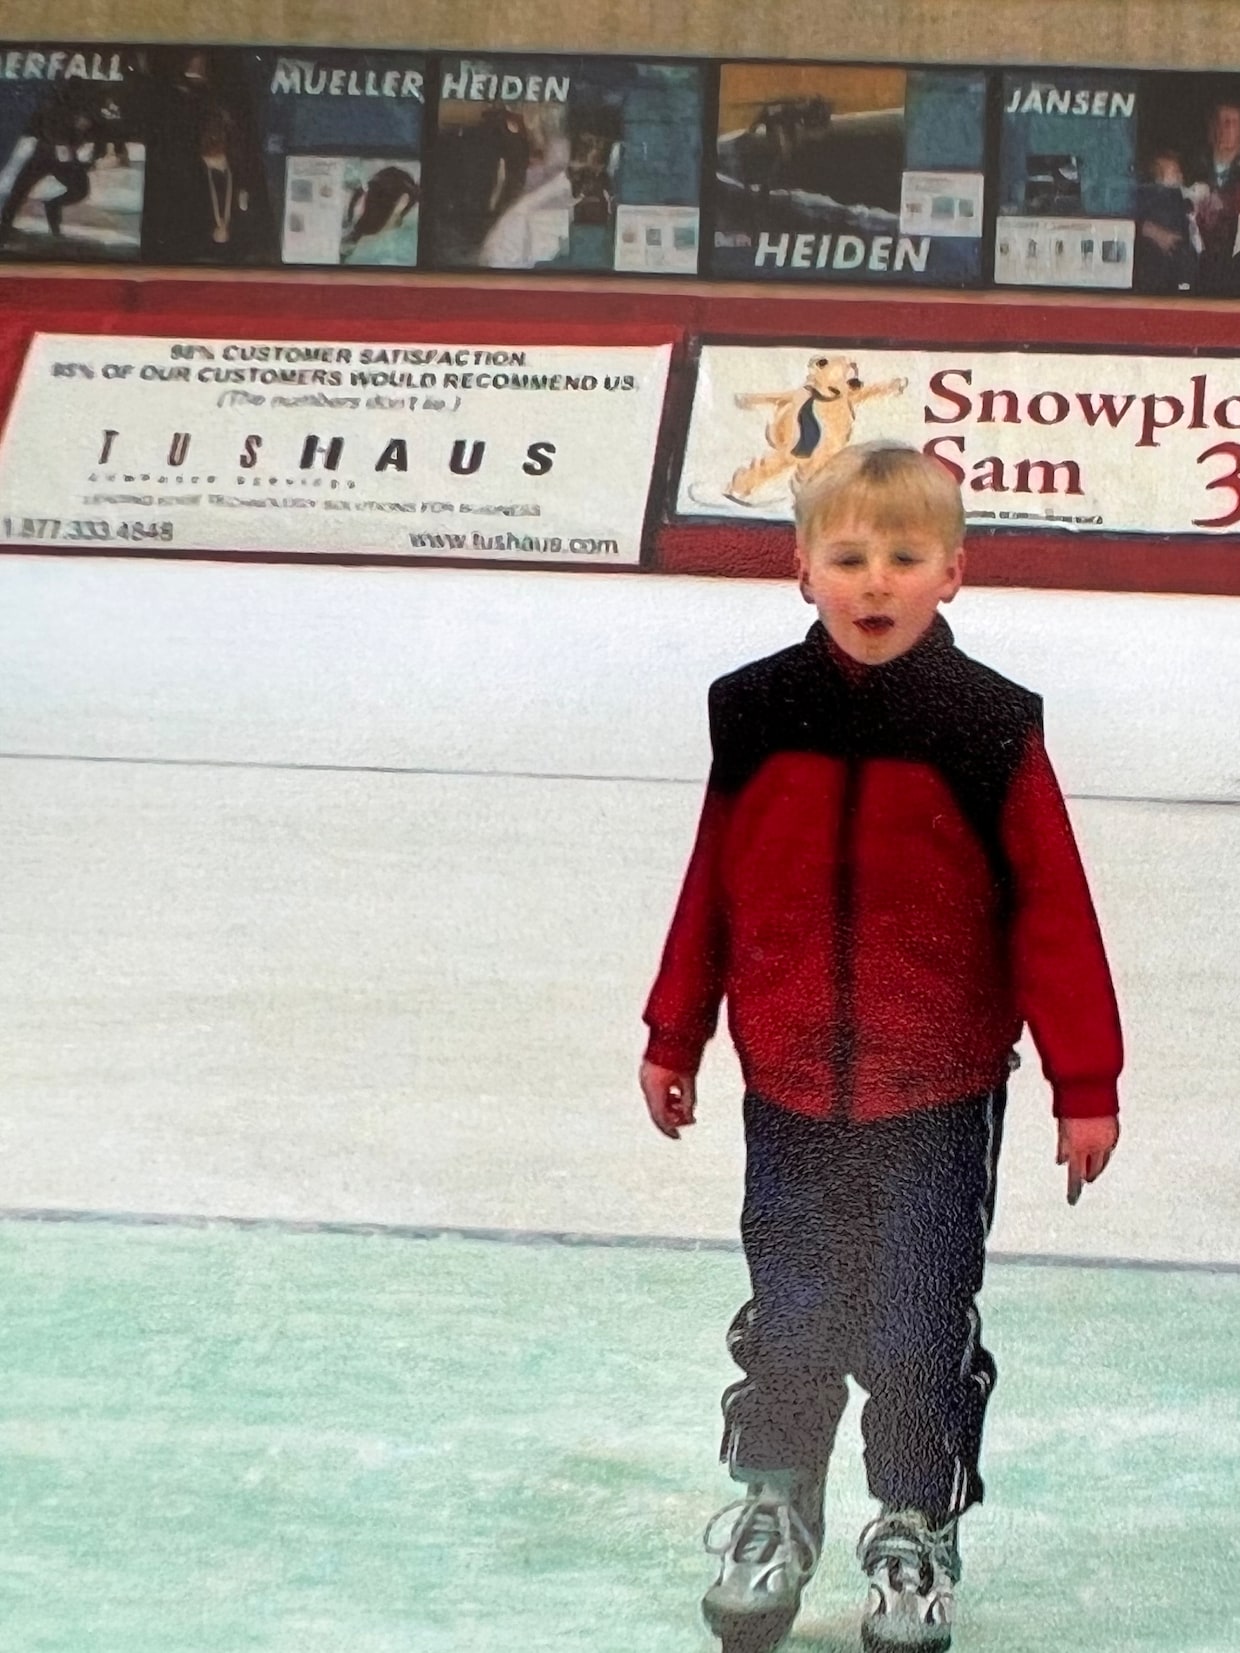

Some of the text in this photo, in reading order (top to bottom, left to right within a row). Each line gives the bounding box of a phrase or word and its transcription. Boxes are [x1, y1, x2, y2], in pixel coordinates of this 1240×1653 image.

[270, 67, 425, 103] MUELLER
[442, 71, 570, 102] HEIDEN
[1004, 89, 1136, 118] JANSEN
[754, 231, 931, 273] HEIDEN
[222, 345, 352, 364] CUSTOMER
[360, 348, 526, 367] SATISFACTION
[101, 363, 134, 380] OF
[140, 364, 191, 382] OUR
[198, 366, 342, 386] CUSTOMERS
[349, 371, 437, 389] WOULD
[443, 373, 598, 391] RECOMMEND
[922, 435, 1085, 496] Sam
[408, 530, 620, 554] www.tushaus.com
